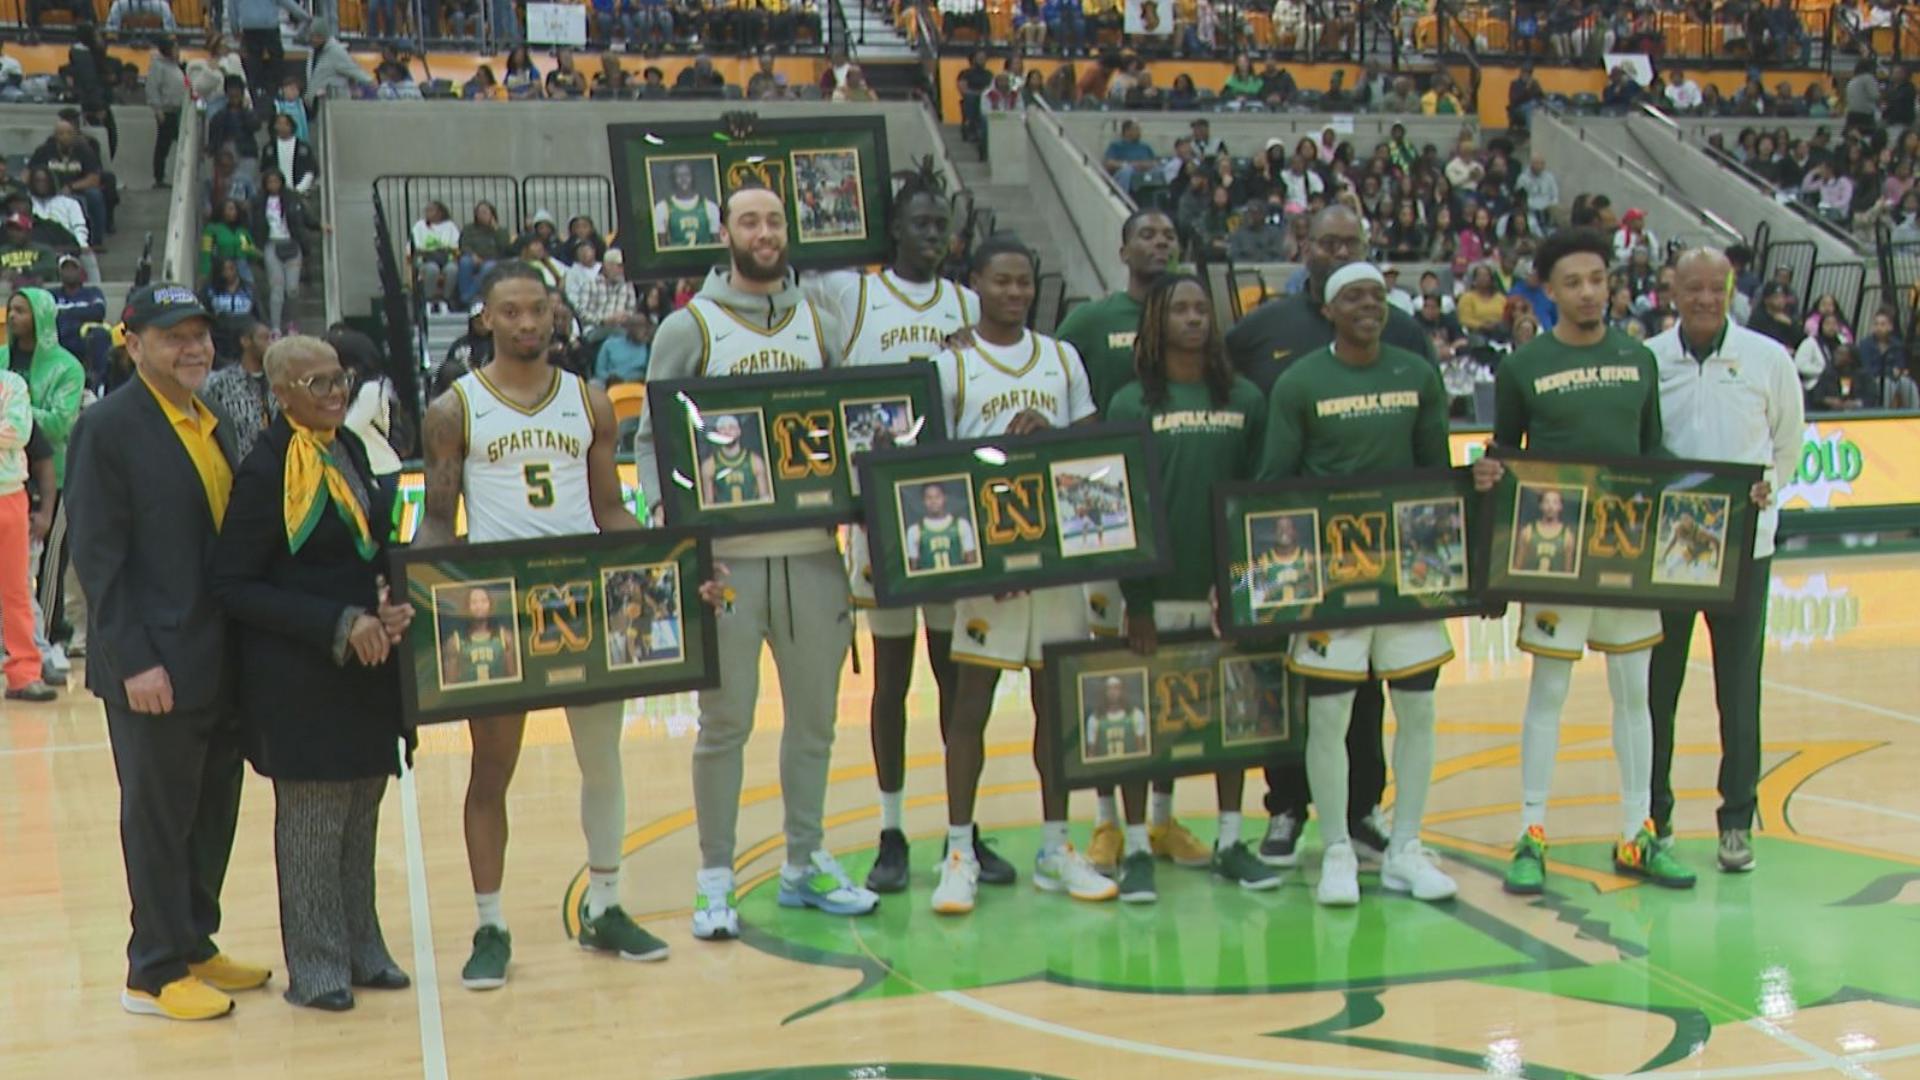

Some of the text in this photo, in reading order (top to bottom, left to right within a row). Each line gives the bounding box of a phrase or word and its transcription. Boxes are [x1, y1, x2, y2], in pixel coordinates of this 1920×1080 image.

[981, 389, 1058, 422] SPARTANS
[1534, 366, 1640, 394] NORFOLK STATE
[487, 428, 580, 463] SPARTANS
[774, 411, 837, 479] N
[1791, 440, 1862, 483] OLD
[524, 463, 555, 508] 5
[982, 475, 1045, 544] N
[1328, 512, 1386, 580] N
[1588, 497, 1652, 558] N
[528, 580, 594, 656] N
[1156, 670, 1212, 733] N
